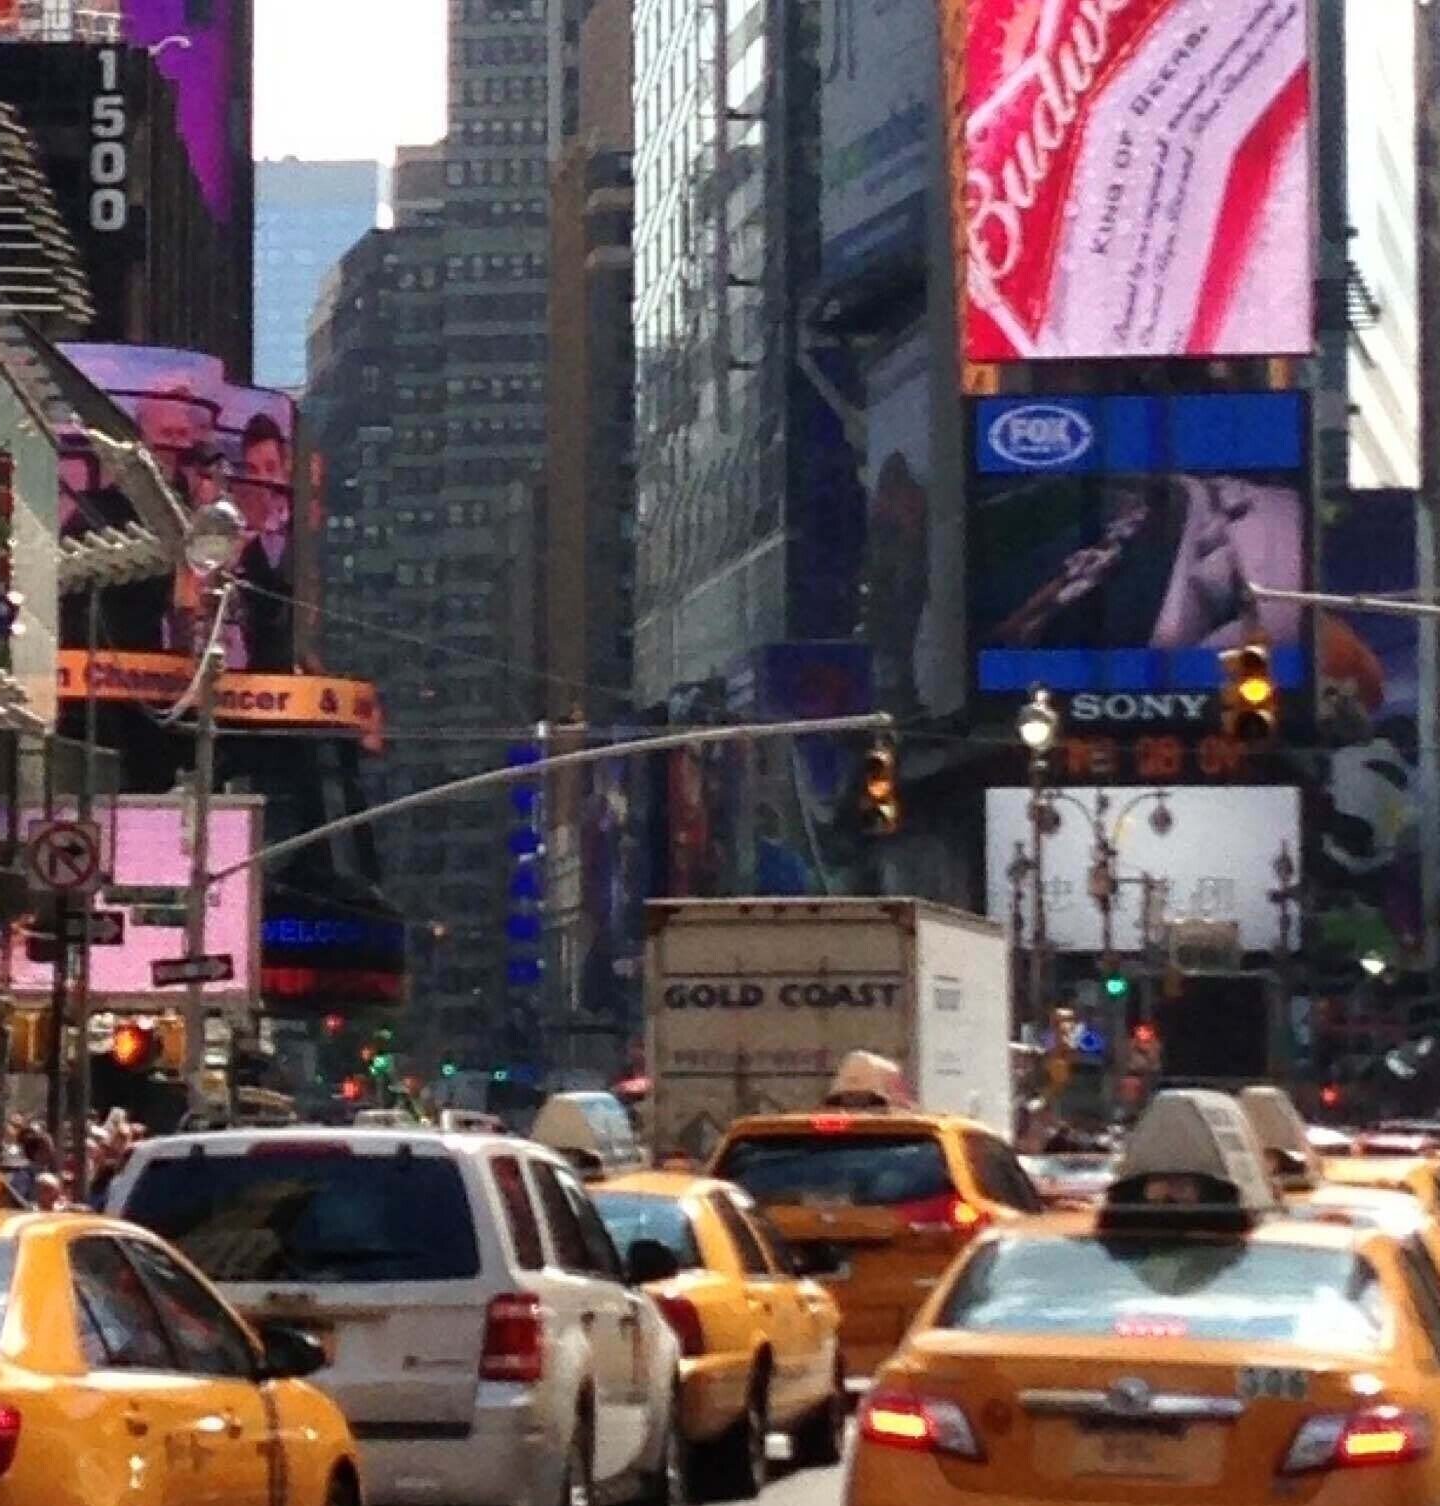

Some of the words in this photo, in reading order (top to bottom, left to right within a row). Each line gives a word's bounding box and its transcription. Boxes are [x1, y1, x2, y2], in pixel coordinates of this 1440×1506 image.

[89, 49, 127, 231] 1500
[1071, 694, 1209, 720] SONY
[663, 983, 765, 1010] GOLD
[778, 982, 902, 1010] COAST
